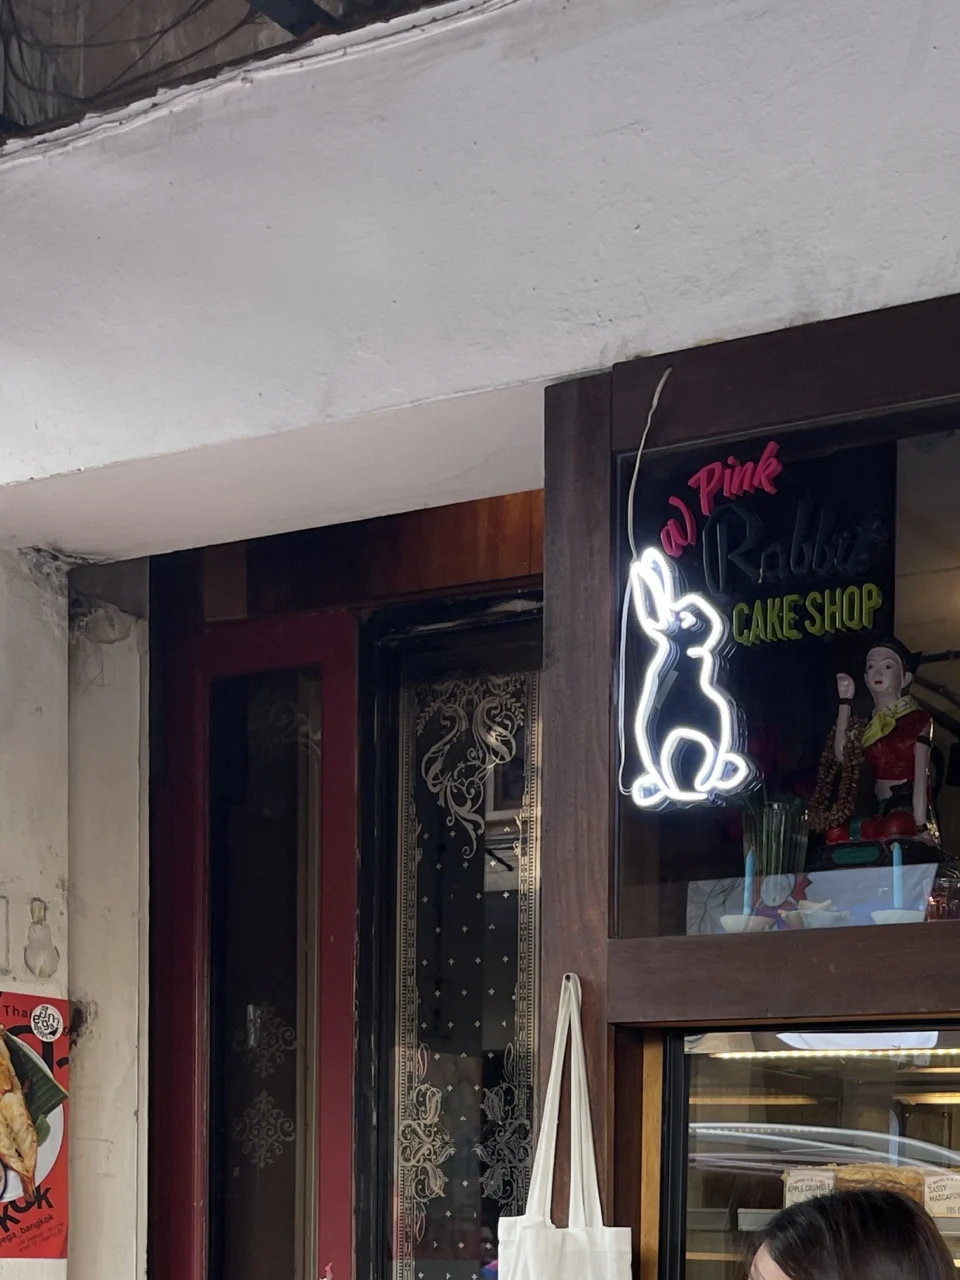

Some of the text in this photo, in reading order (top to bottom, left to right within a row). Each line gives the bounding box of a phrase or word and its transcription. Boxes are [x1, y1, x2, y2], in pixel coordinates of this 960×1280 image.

[688, 440, 783, 517] Pink
[732, 583, 883, 646] CAKE SHOP
[928, 1185, 947, 1194] SASSY
